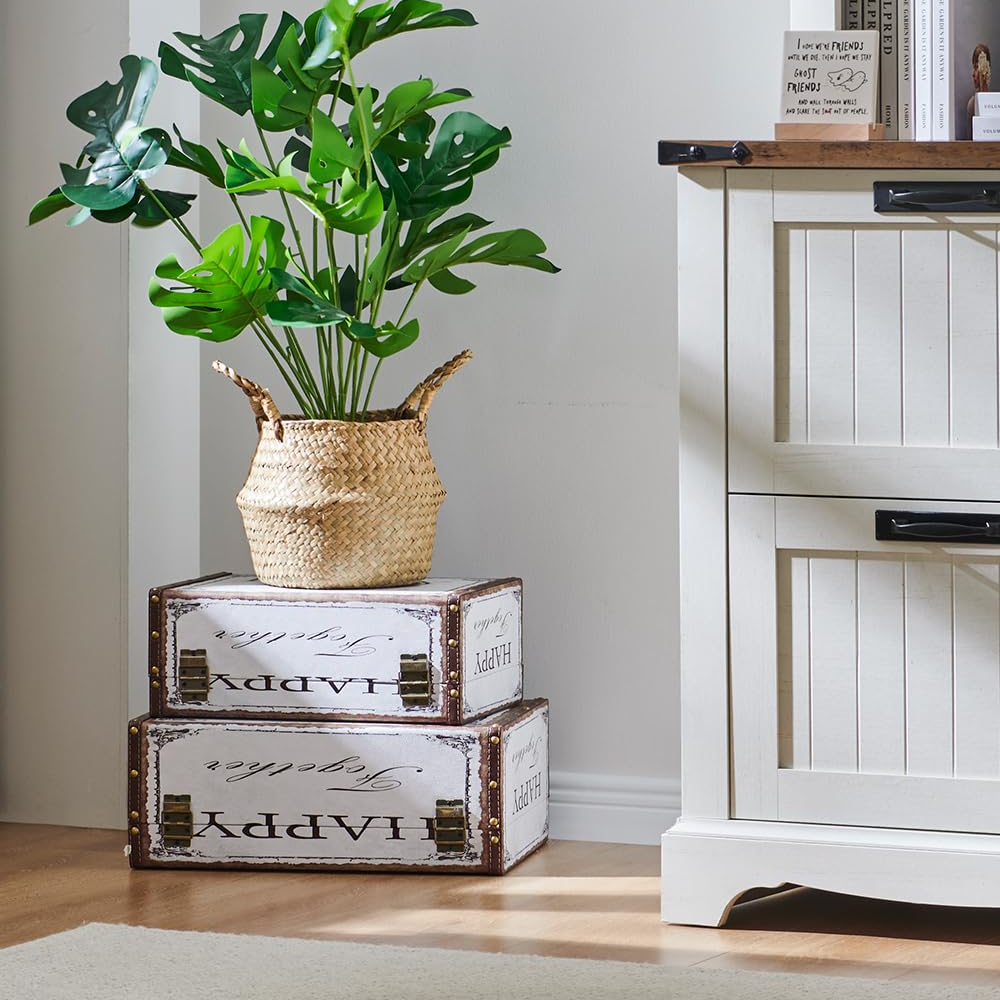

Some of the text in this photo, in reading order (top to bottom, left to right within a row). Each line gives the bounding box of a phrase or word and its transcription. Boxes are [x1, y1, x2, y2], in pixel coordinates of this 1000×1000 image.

[832, 41, 864, 52] FRIENDS
[794, 68, 817, 79] GHOST
[787, 82, 821, 94] FRIENDS
[474, 642, 512, 675] HAPPY
[512, 772, 542, 816] HAPPY
